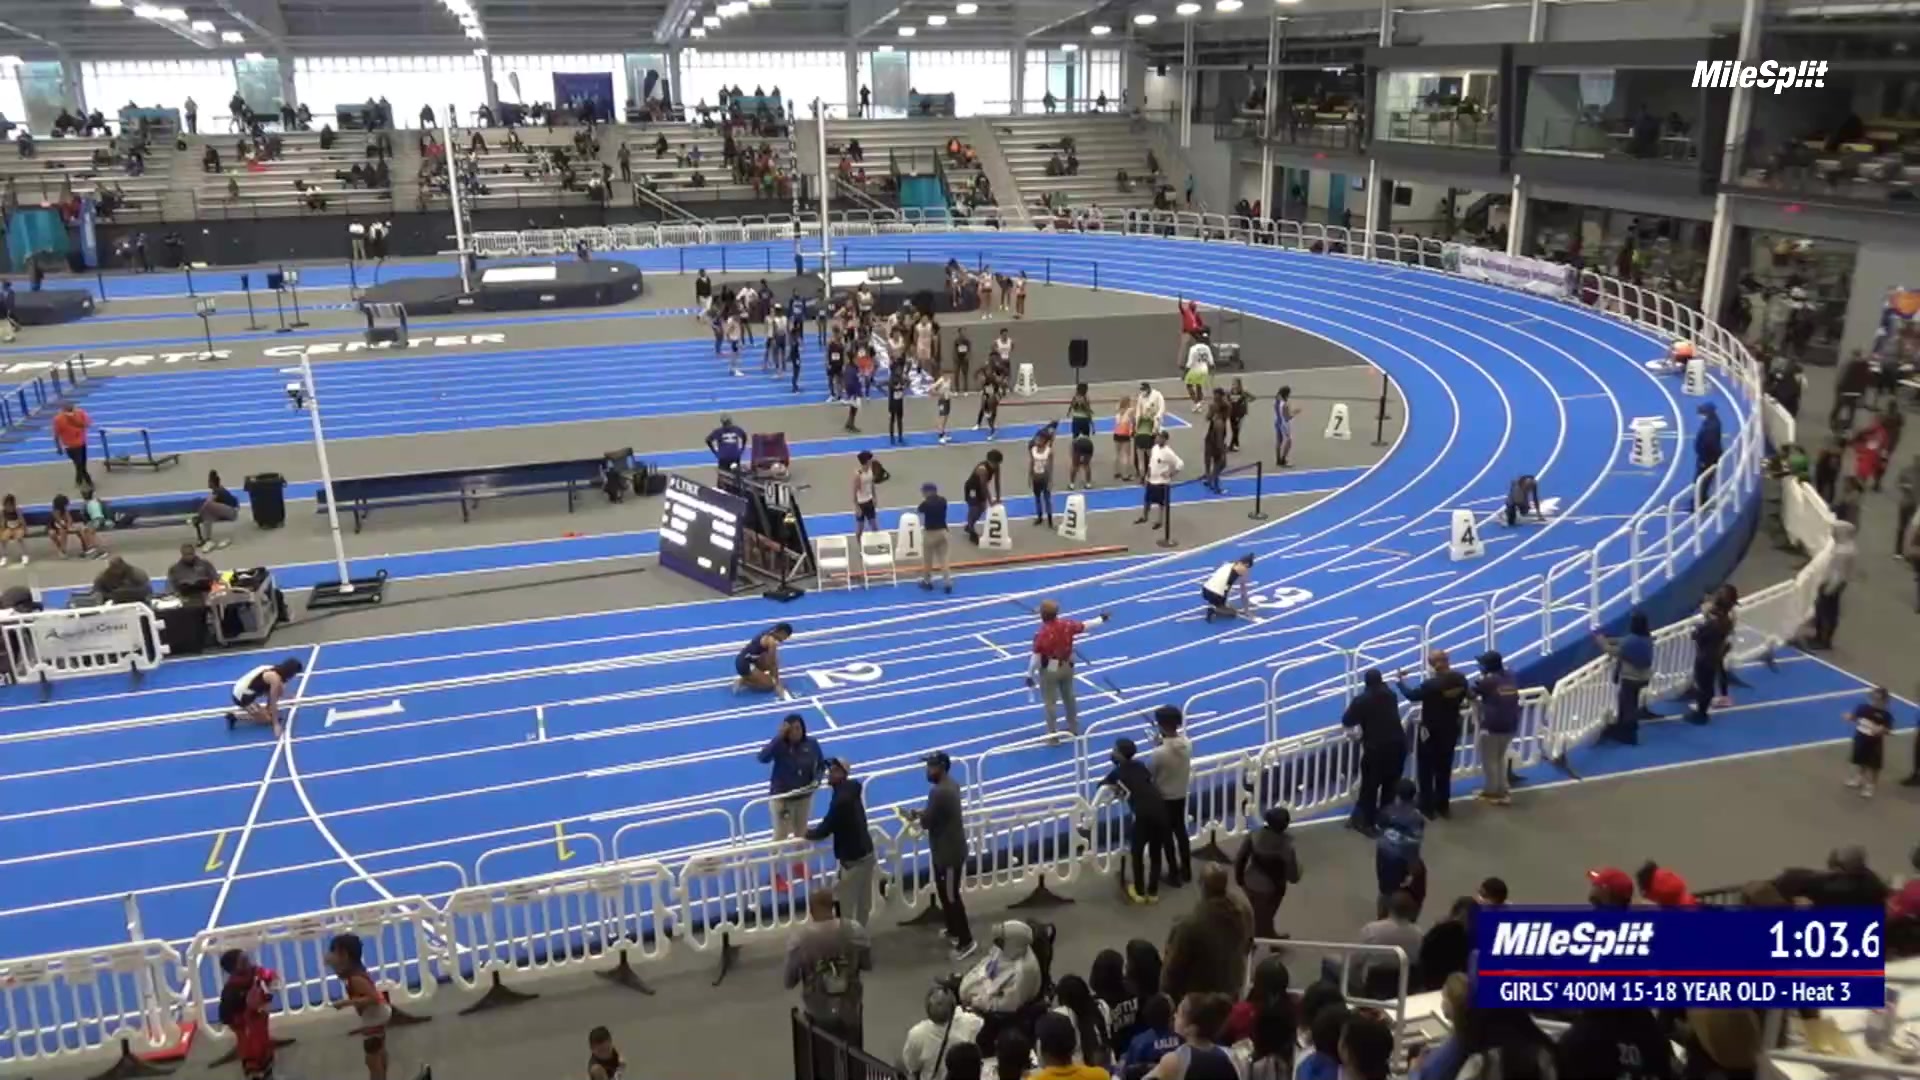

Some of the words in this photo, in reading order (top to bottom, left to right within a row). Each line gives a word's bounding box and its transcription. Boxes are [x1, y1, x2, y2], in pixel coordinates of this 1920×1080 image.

[0, 350, 232, 373] PORTS
[1334, 415, 1344, 431] 7
[988, 518, 1002, 539] 2
[1066, 509, 1078, 528] 3
[1461, 525, 1475, 546] 4
[1248, 587, 1315, 608] 3
[805, 662, 883, 690] 2
[323, 699, 406, 728] 1
